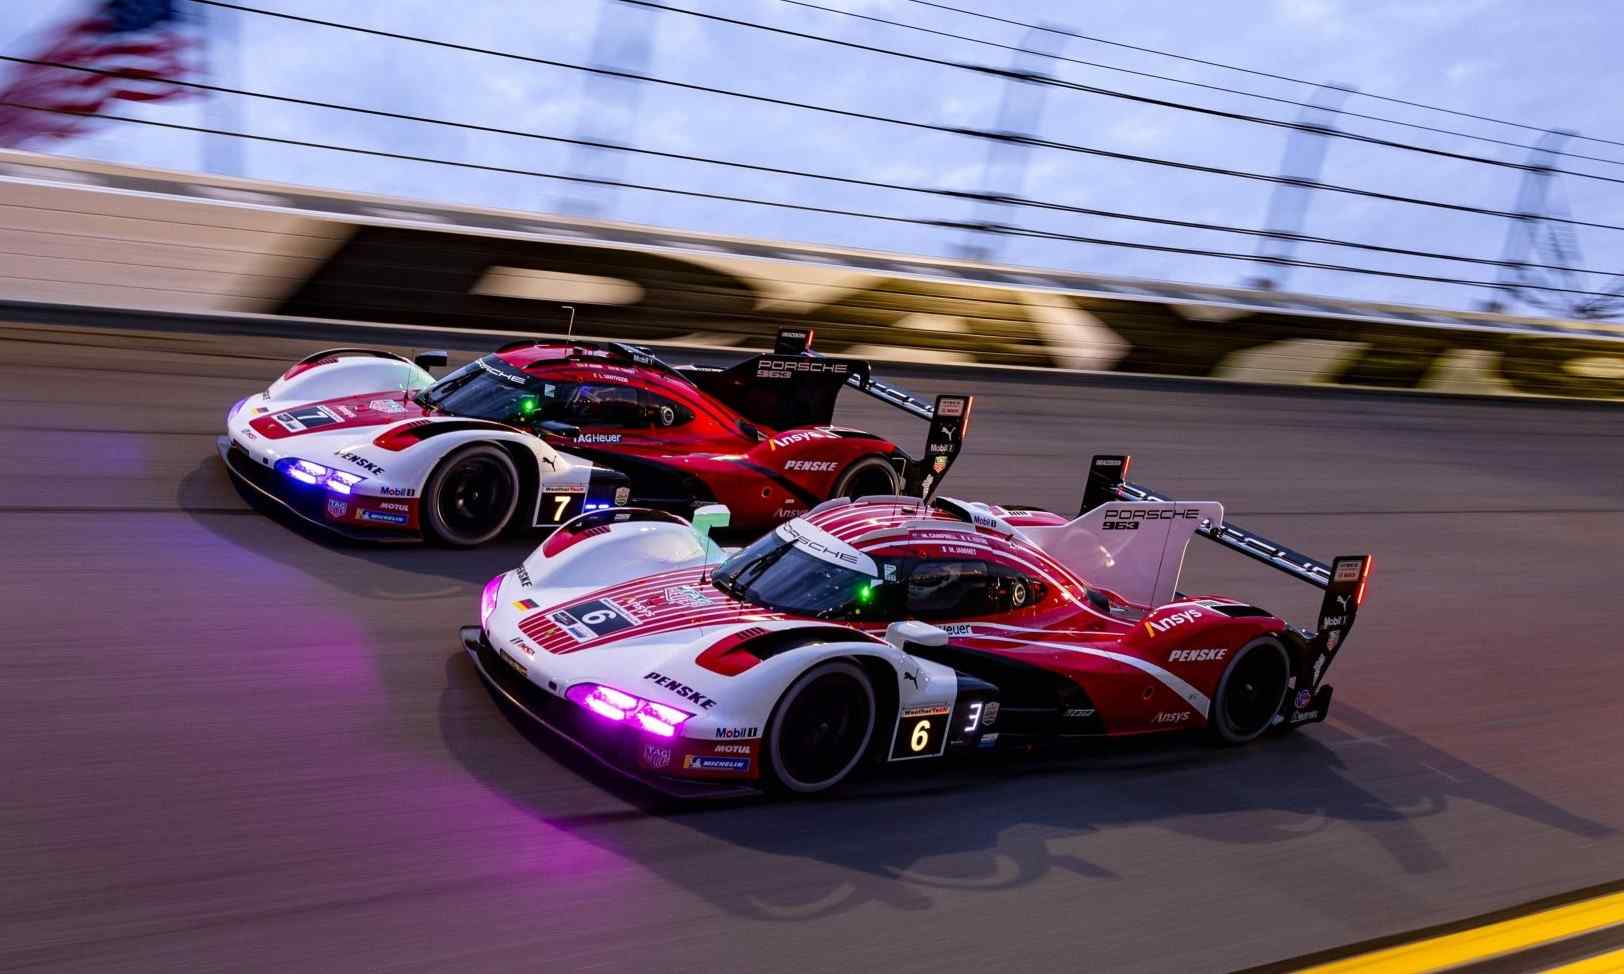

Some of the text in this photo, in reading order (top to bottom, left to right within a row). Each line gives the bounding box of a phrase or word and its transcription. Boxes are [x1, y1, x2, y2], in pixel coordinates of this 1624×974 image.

[758, 360, 848, 373] PORSCHE
[756, 369, 792, 378] 963
[297, 410, 328, 420] 7
[593, 433, 621, 442] Heuer
[784, 459, 839, 472] PENSKE
[381, 486, 406, 496] Mobil
[554, 495, 572, 522] 7
[1104, 509, 1200, 520] PORSCHE
[974, 515, 990, 526] Mobil
[1102, 521, 1139, 530] 963
[582, 609, 617, 625] 6
[1144, 609, 1202, 638] Ansys
[1168, 648, 1228, 662] PENSKE
[643, 672, 717, 710] PENSKE
[964, 703, 983, 732] 3
[1152, 711, 1191, 723] Ansys
[715, 727, 746, 738] Mobil
[911, 720, 931, 752] 6
[714, 744, 751, 754] MOTUL
[703, 760, 744, 768] MICHELIN
